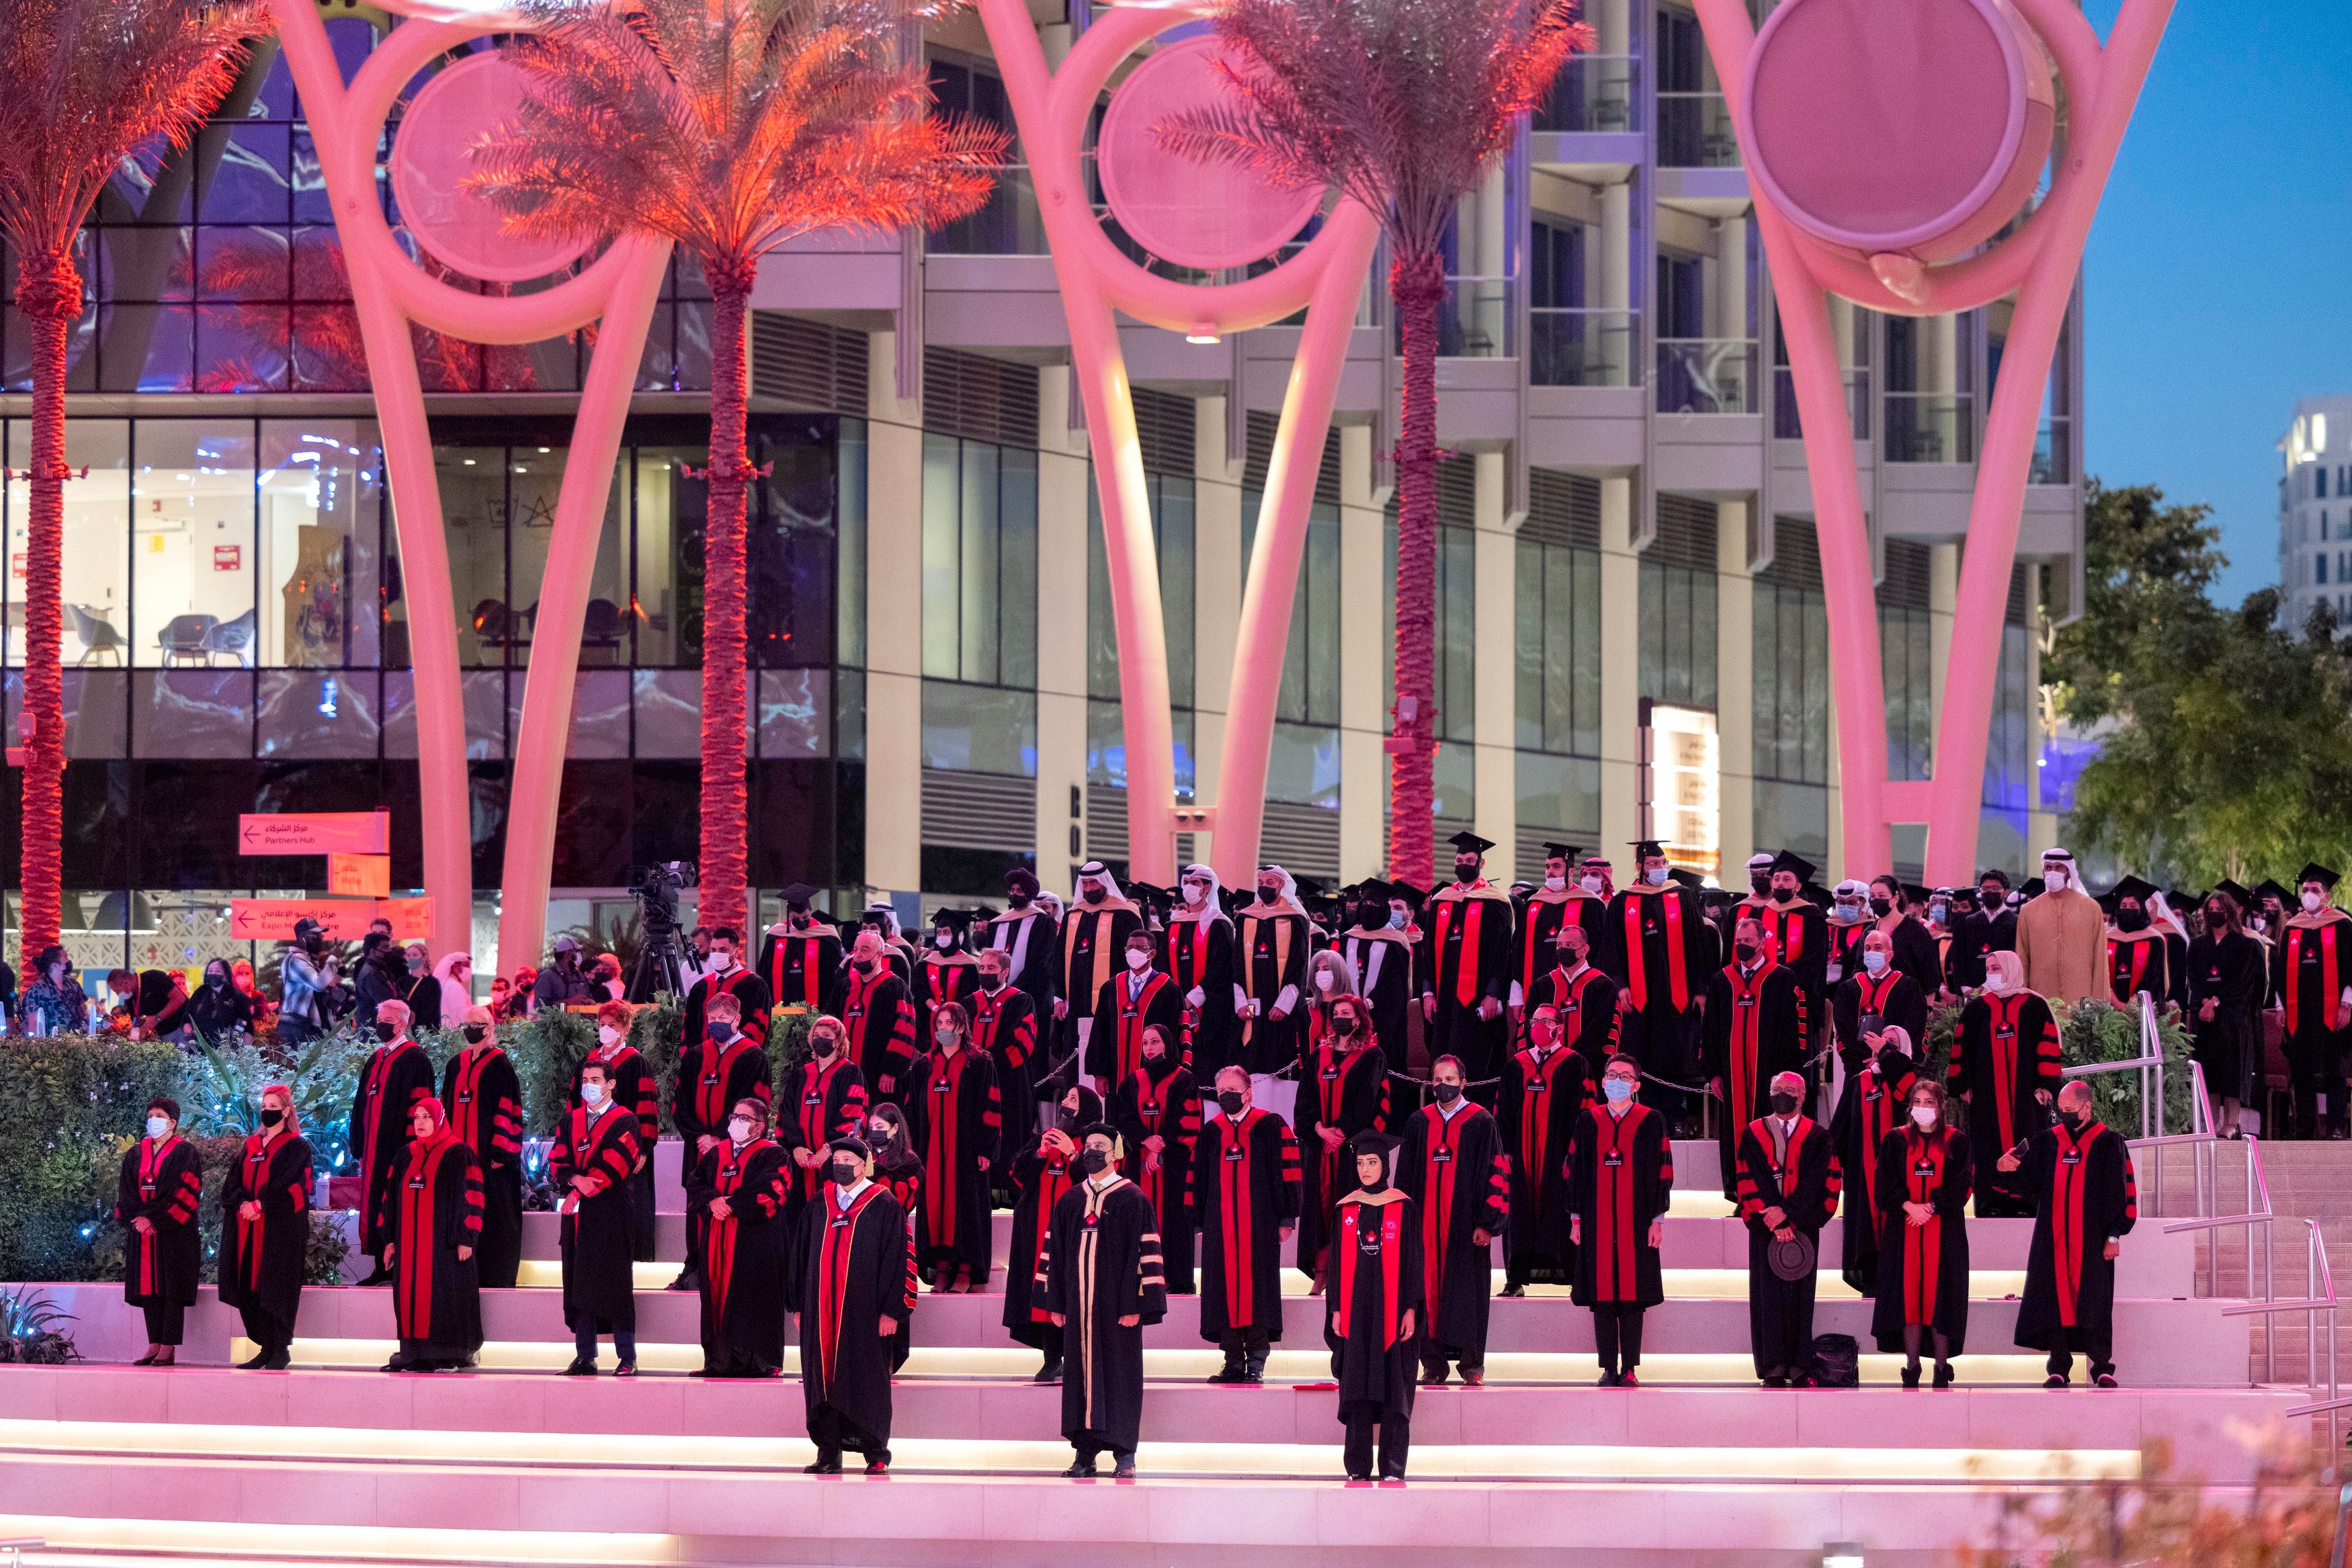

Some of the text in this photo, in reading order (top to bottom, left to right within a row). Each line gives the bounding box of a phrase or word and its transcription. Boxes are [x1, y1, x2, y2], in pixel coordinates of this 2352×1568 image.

[265, 824, 308, 833] مركز الشركاء
[320, 910, 336, 919] مركز
[261, 922, 282, 930] Expo
